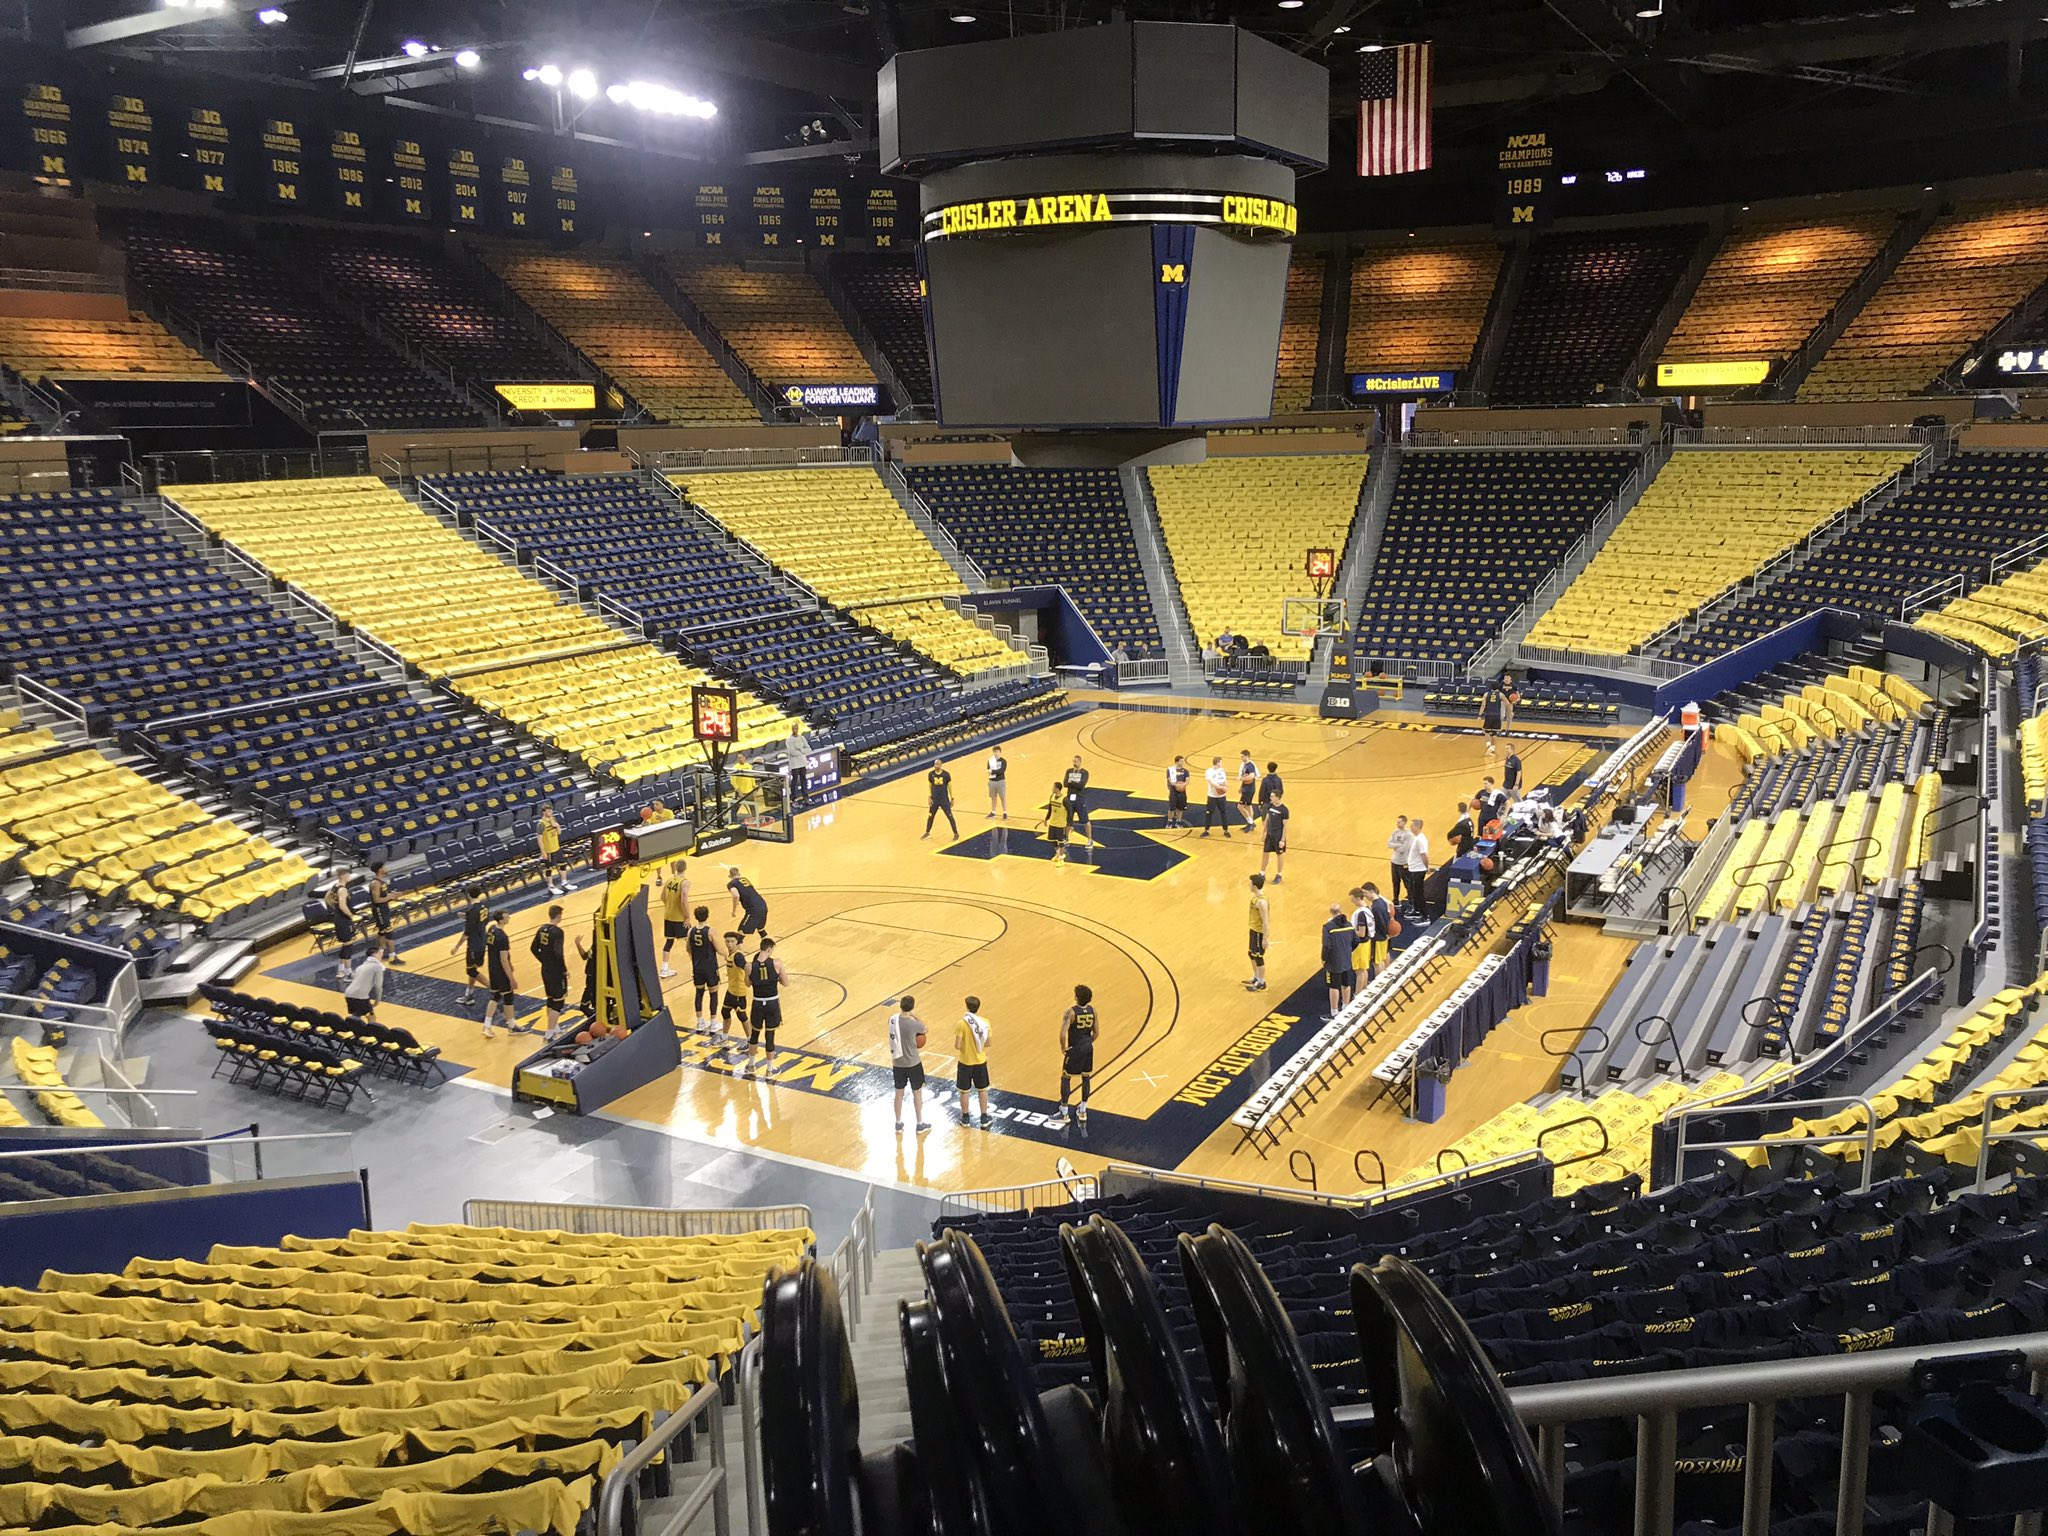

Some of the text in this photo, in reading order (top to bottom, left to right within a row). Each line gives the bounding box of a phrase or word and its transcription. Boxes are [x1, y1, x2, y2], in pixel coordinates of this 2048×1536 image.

[117, 138, 149, 155] 1974
[1507, 133, 1546, 149] NCAA
[196, 149, 225, 165] 1977
[1499, 147, 1554, 161] CHAMPIONS
[43, 155, 65, 174] M
[272, 159, 300, 175] 1985
[126, 165, 147, 182] M
[338, 168, 363, 183] 1986
[204, 175, 224, 192] M
[400, 177, 422, 191] 2012
[455, 183, 477, 197] 2014
[700, 186, 724, 194] NCAA
[1507, 178, 1542, 195] 1989
[278, 183, 296, 200] M
[507, 190, 527, 204] 2017
[756, 187, 780, 195] NCAA
[813, 188, 837, 197] NCAA
[870, 189, 894, 198] NCAA
[345, 191, 362, 207] M
[557, 198, 576, 211] 2018
[406, 199, 421, 214] M
[461, 205, 475, 220] M
[942, 193, 1113, 234] CRISLER ARENA
[1223, 195, 1286, 229] CRISLER
[512, 211, 526, 226] M
[701, 214, 725, 225] 1964
[758, 215, 781, 225] 1965
[815, 215, 838, 227] 1976
[1512, 206, 1535, 223] M
[560, 218, 574, 233] M
[872, 217, 895, 228] 1989
[706, 233, 721, 244] M
[763, 233, 779, 245] M
[820, 234, 835, 246] M
[876, 235, 891, 247] M
[1161, 264, 1184, 283] M
[1365, 376, 1440, 391] #CrislerLIVE
[557, 387, 593, 395] MICHIGAN
[805, 387, 838, 396] ALWAYS
[805, 395, 842, 404] FOREVER
[1312, 563, 1329, 575] 24
[1334, 656, 1347, 666] M
[1327, 697, 1350, 708] B1G
[702, 710, 727, 736] 24
[1232, 711, 1438, 732] MICHIGAN
[600, 845, 617, 862] 24
[667, 881, 679, 893] 44
[1446, 887, 1482, 912] M
[694, 934, 703, 946] 5
[759, 967, 768, 980] 11
[1076, 1014, 1094, 1029] 55
[1173, 1012, 1301, 1107] MGOBLUE.COM
[1644, 1324, 1665, 1333] OUR
[1674, 1458, 1743, 1474] THIS IS OU
